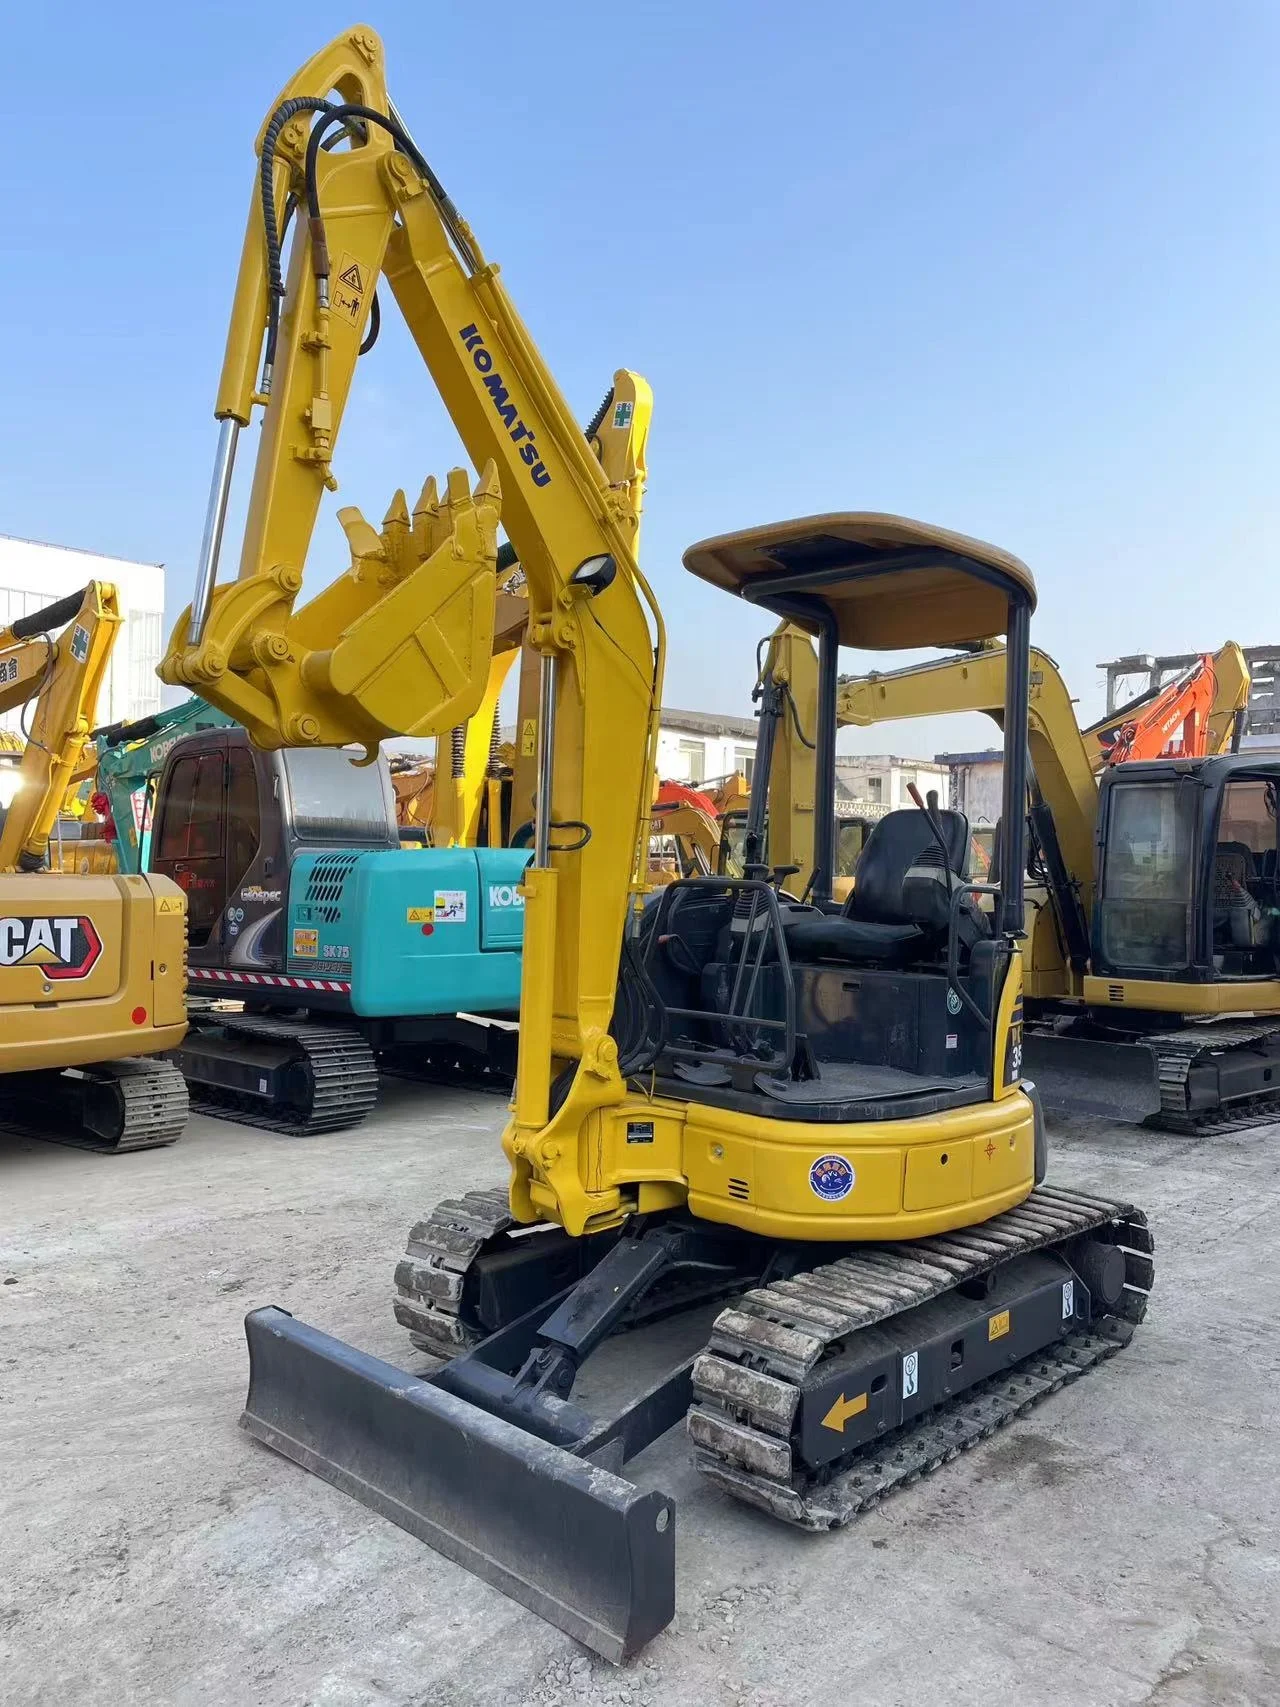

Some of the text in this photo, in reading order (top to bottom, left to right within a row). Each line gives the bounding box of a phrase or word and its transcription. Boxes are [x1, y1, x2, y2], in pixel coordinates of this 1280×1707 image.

[459, 323, 552, 488] KOMATSU
[0, 917, 79, 966] CAT
[323, 944, 350, 958] SK75
